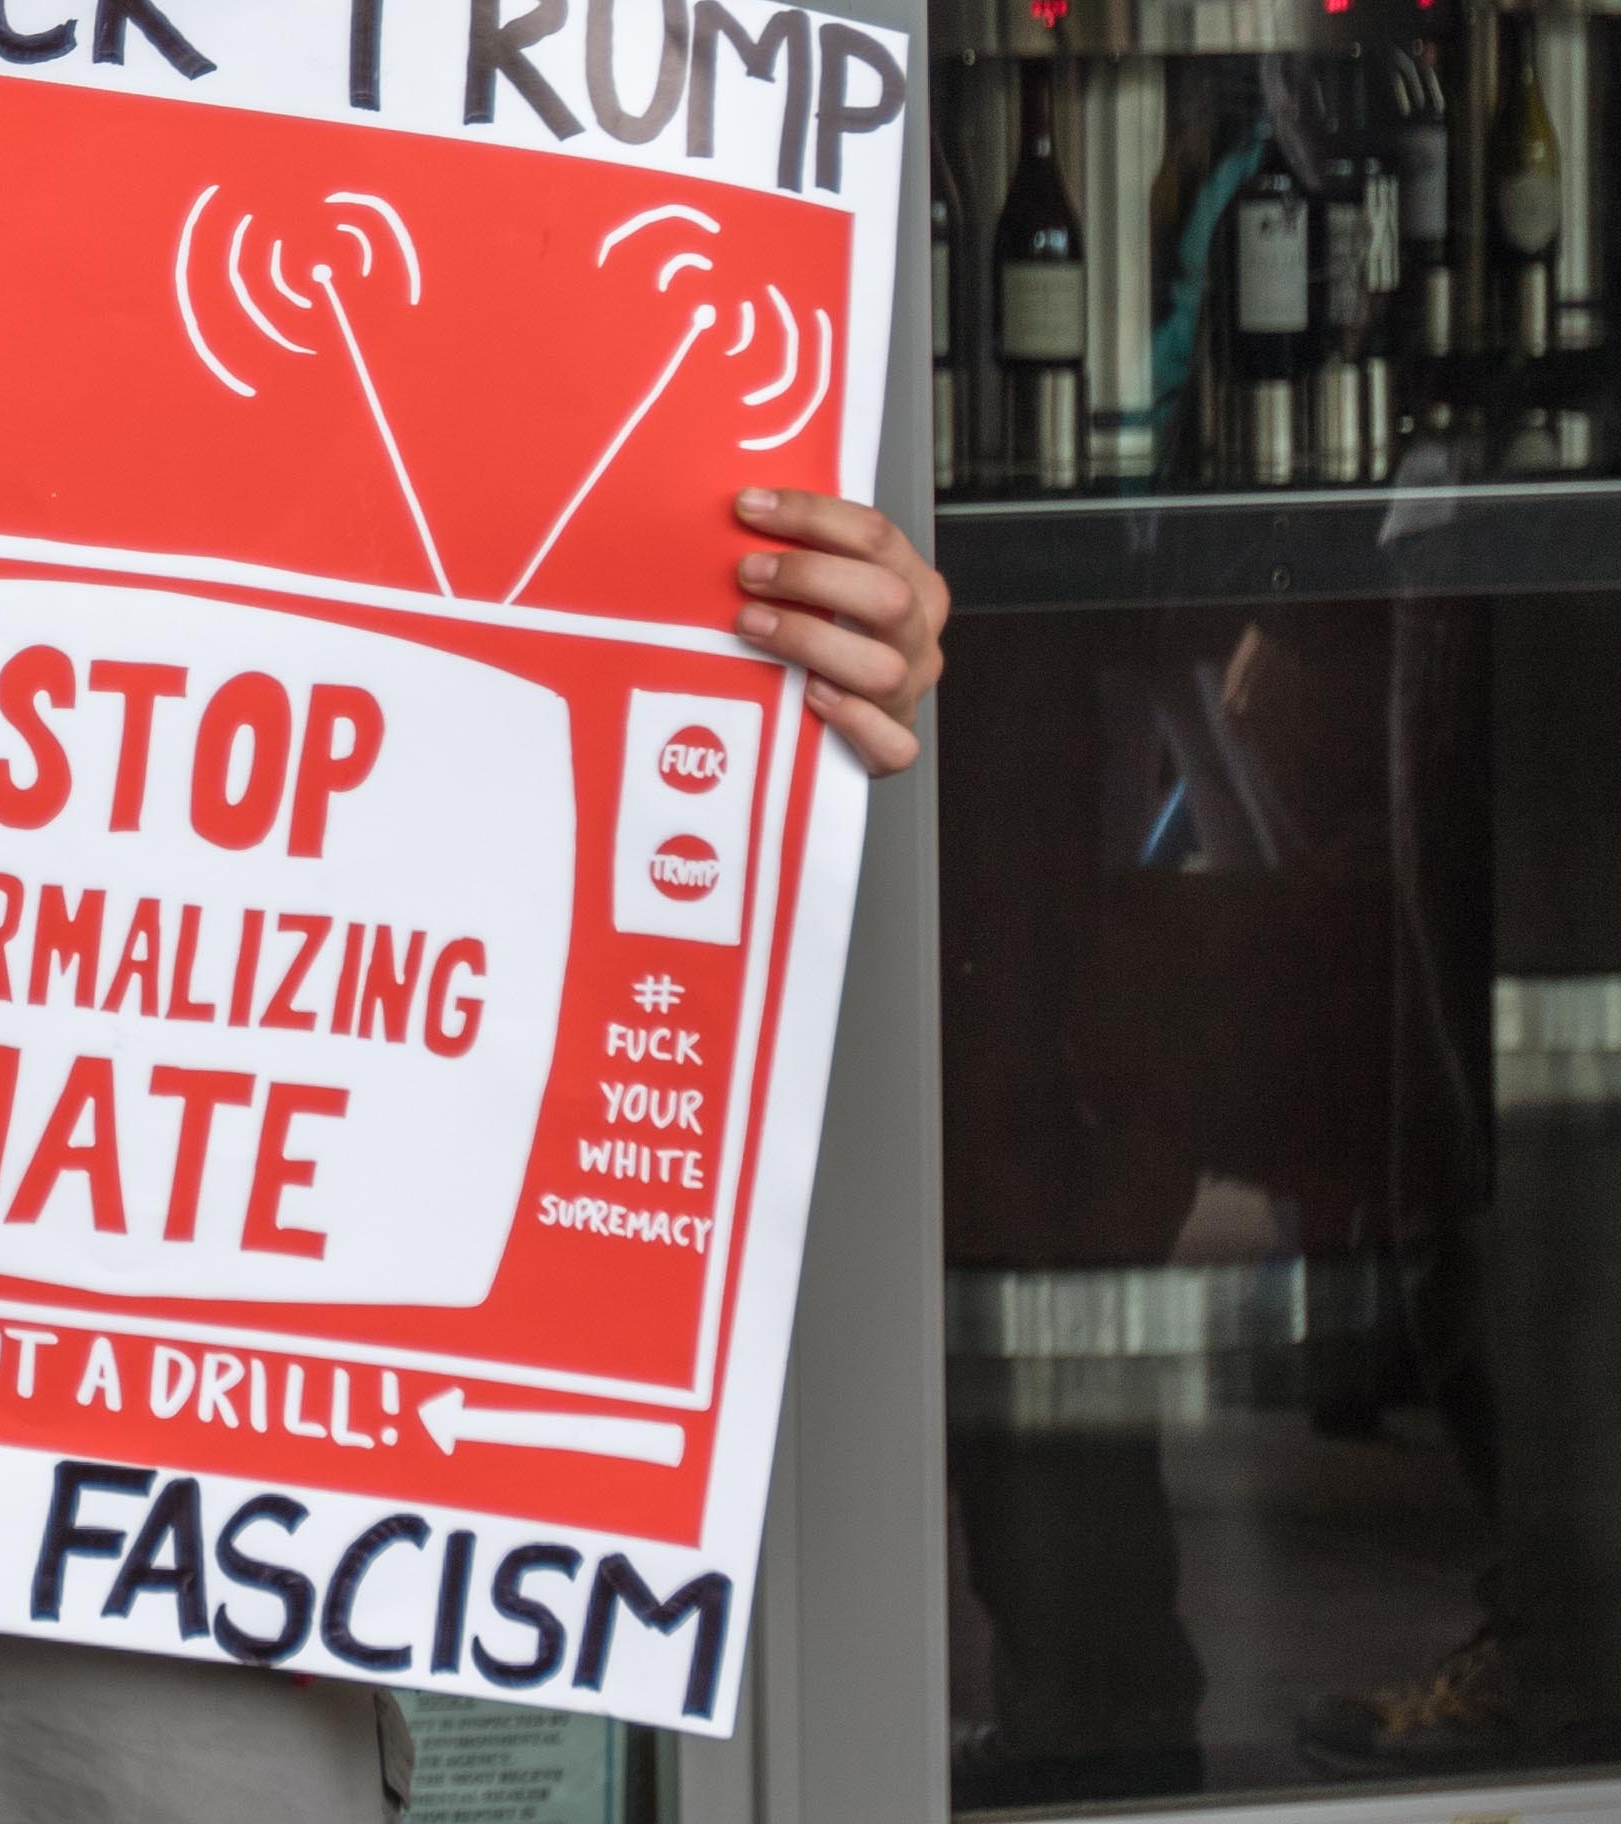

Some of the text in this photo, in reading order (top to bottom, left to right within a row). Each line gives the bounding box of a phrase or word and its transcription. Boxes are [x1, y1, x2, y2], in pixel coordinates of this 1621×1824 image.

[659, 742, 727, 780] FUCK
[647, 852, 721, 890] TRUMP
[631, 973, 686, 1015] #
[606, 1022, 703, 1067] FUCK
[600, 1080, 703, 1136] YOUR
[577, 1137, 704, 1190] WHITE
[537, 1192, 713, 1255] SUPREMACY
[75, 1336, 123, 1413] A
[149, 1343, 401, 1449] DRILL!
[29, 1459, 734, 1721] FASCISM
